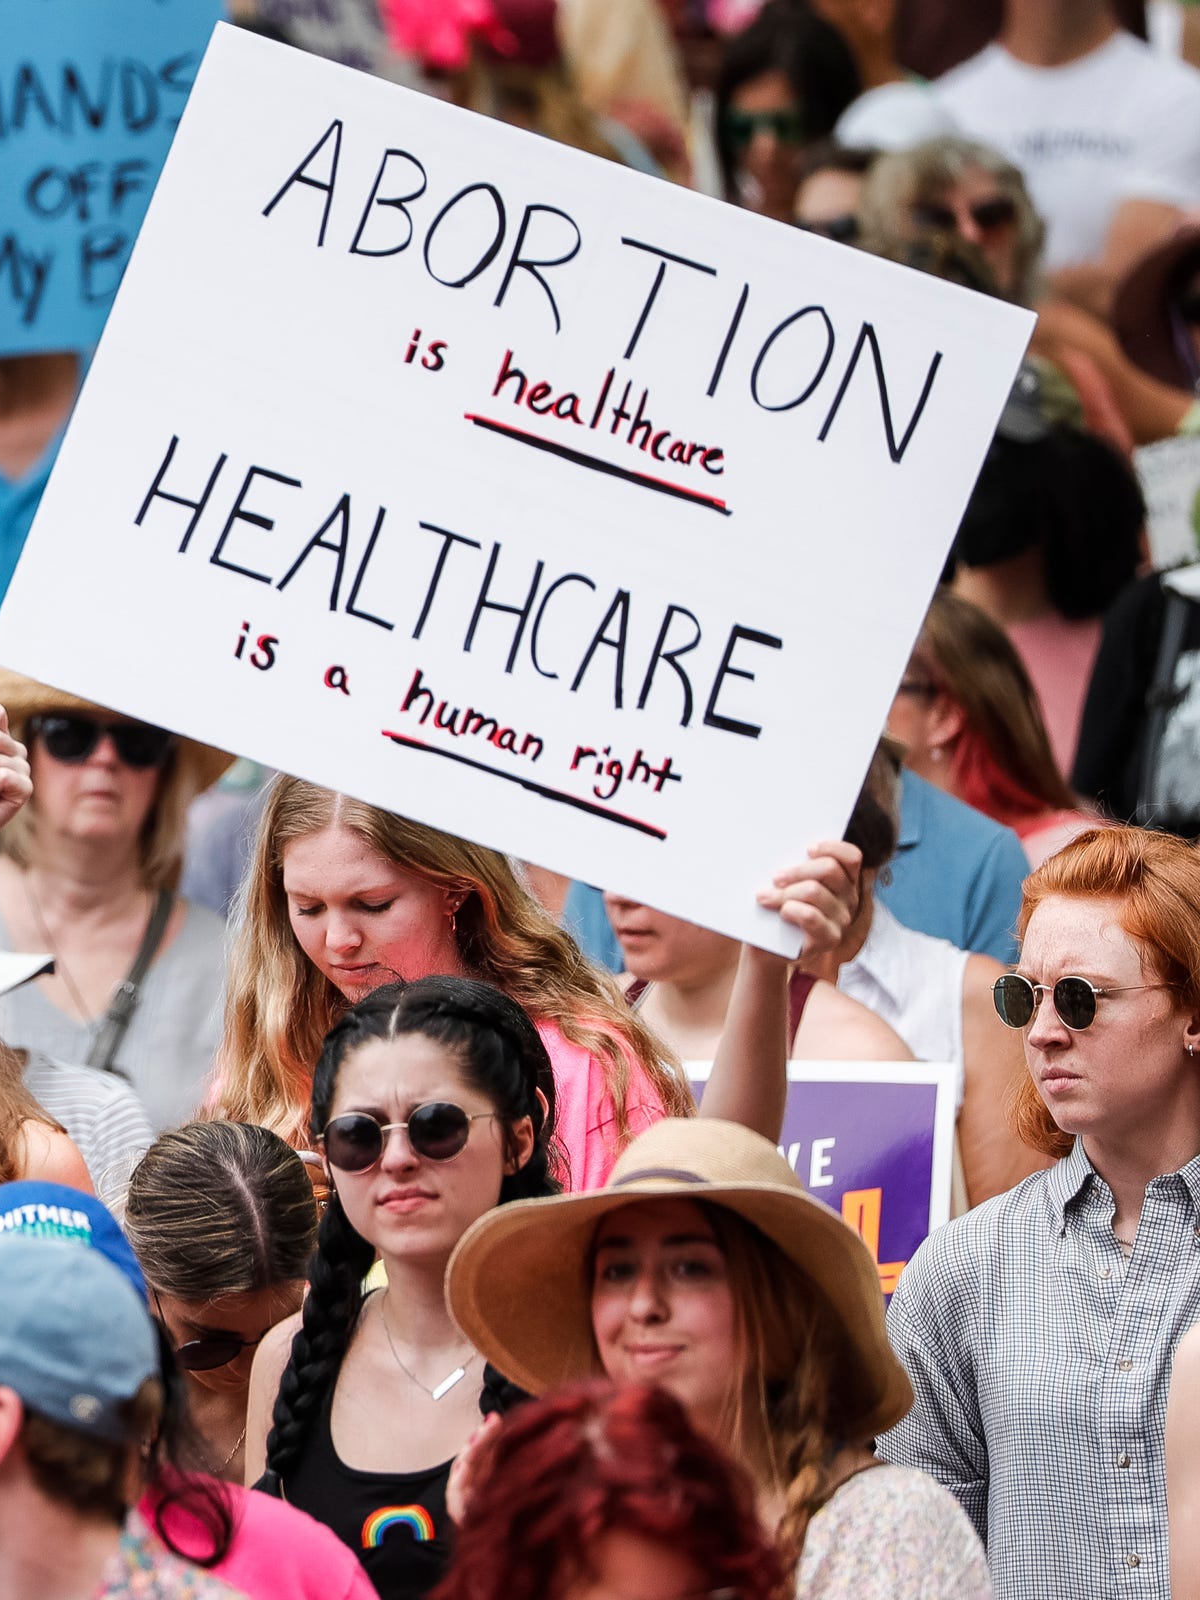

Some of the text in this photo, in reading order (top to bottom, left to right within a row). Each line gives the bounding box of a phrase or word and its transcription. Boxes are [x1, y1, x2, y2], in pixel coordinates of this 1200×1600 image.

[25, 158, 150, 222] OFF
[80, 225, 133, 308] B
[261, 118, 944, 465] ABORTION
[404, 328, 726, 477] is healthcare
[133, 434, 784, 741] HEALTHCARE
[234, 621, 683, 801] is a human right
